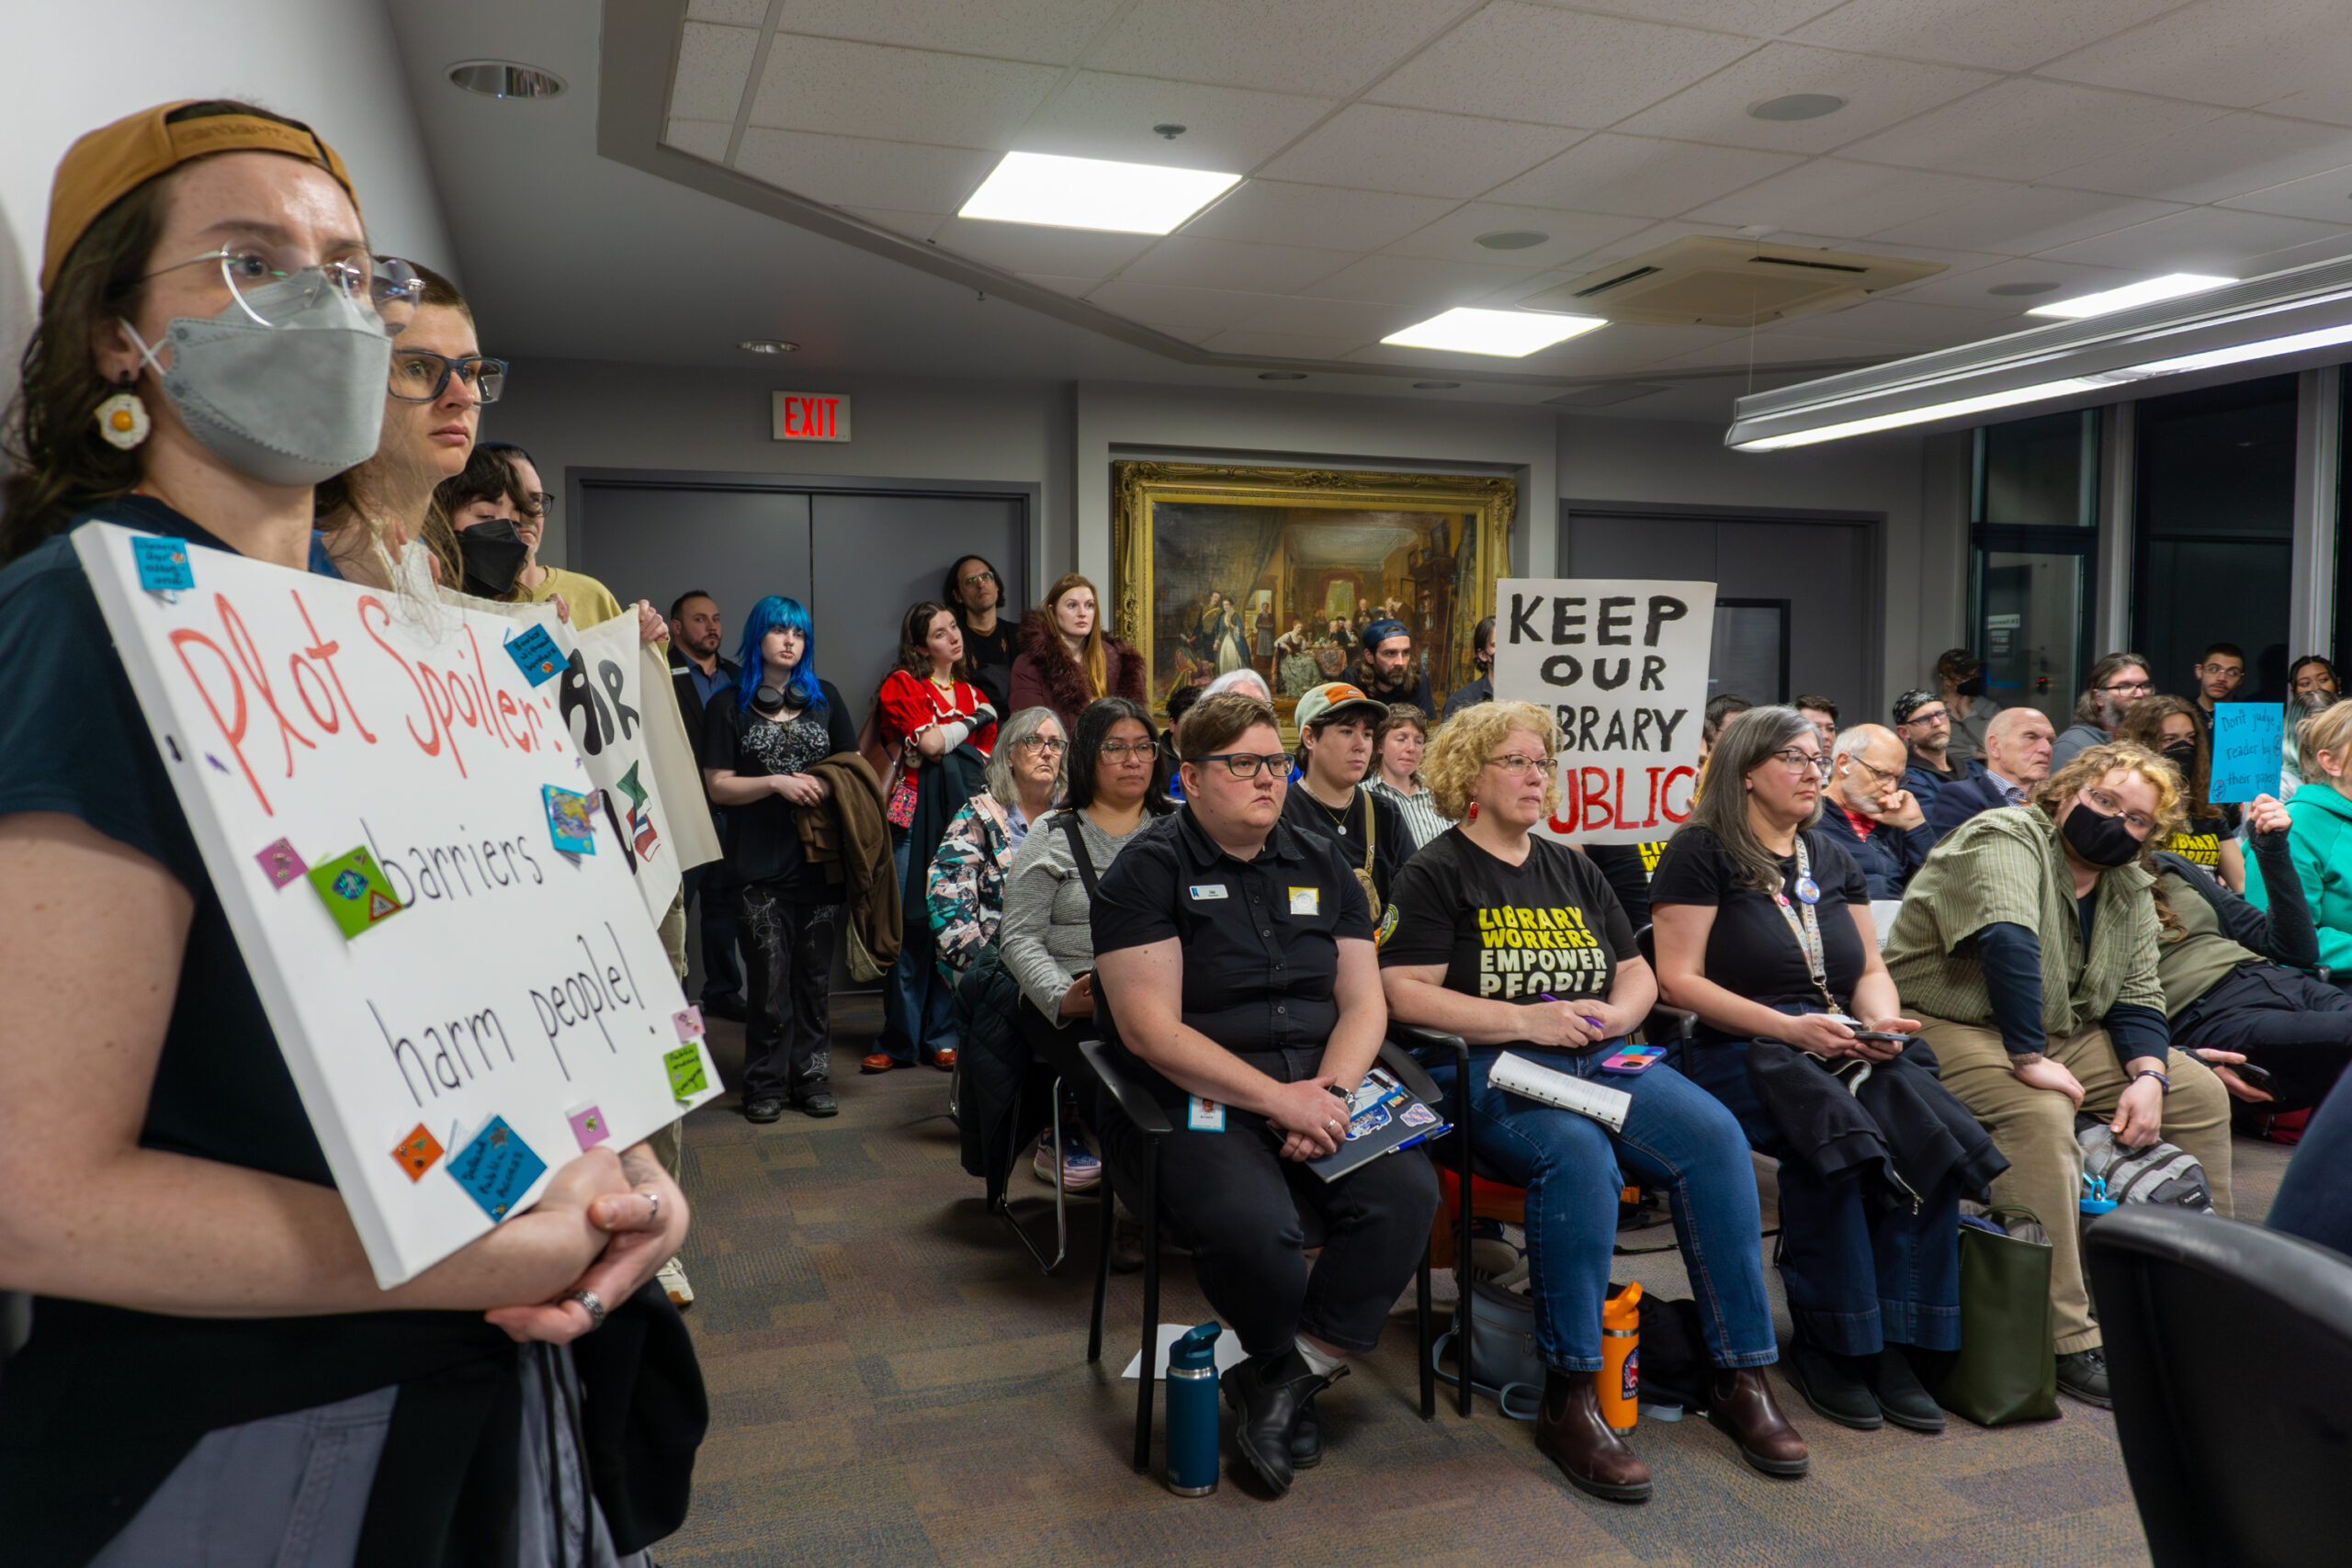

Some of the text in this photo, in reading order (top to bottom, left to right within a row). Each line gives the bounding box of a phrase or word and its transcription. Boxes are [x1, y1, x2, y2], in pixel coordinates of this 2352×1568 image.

[785, 397, 839, 438] EXIT
[1509, 593, 1689, 647] KEEP
[1540, 654, 1667, 691] OUR
[1540, 704, 1689, 752] BRARY
[1547, 765, 1695, 834] UBLIC
[359, 816, 543, 909] barriers
[1478, 905, 1586, 931] LIBRARY
[1480, 928, 1599, 949] WORKERS
[1480, 947, 1608, 973] EMPOWER
[366, 920, 656, 1108] harm people!
